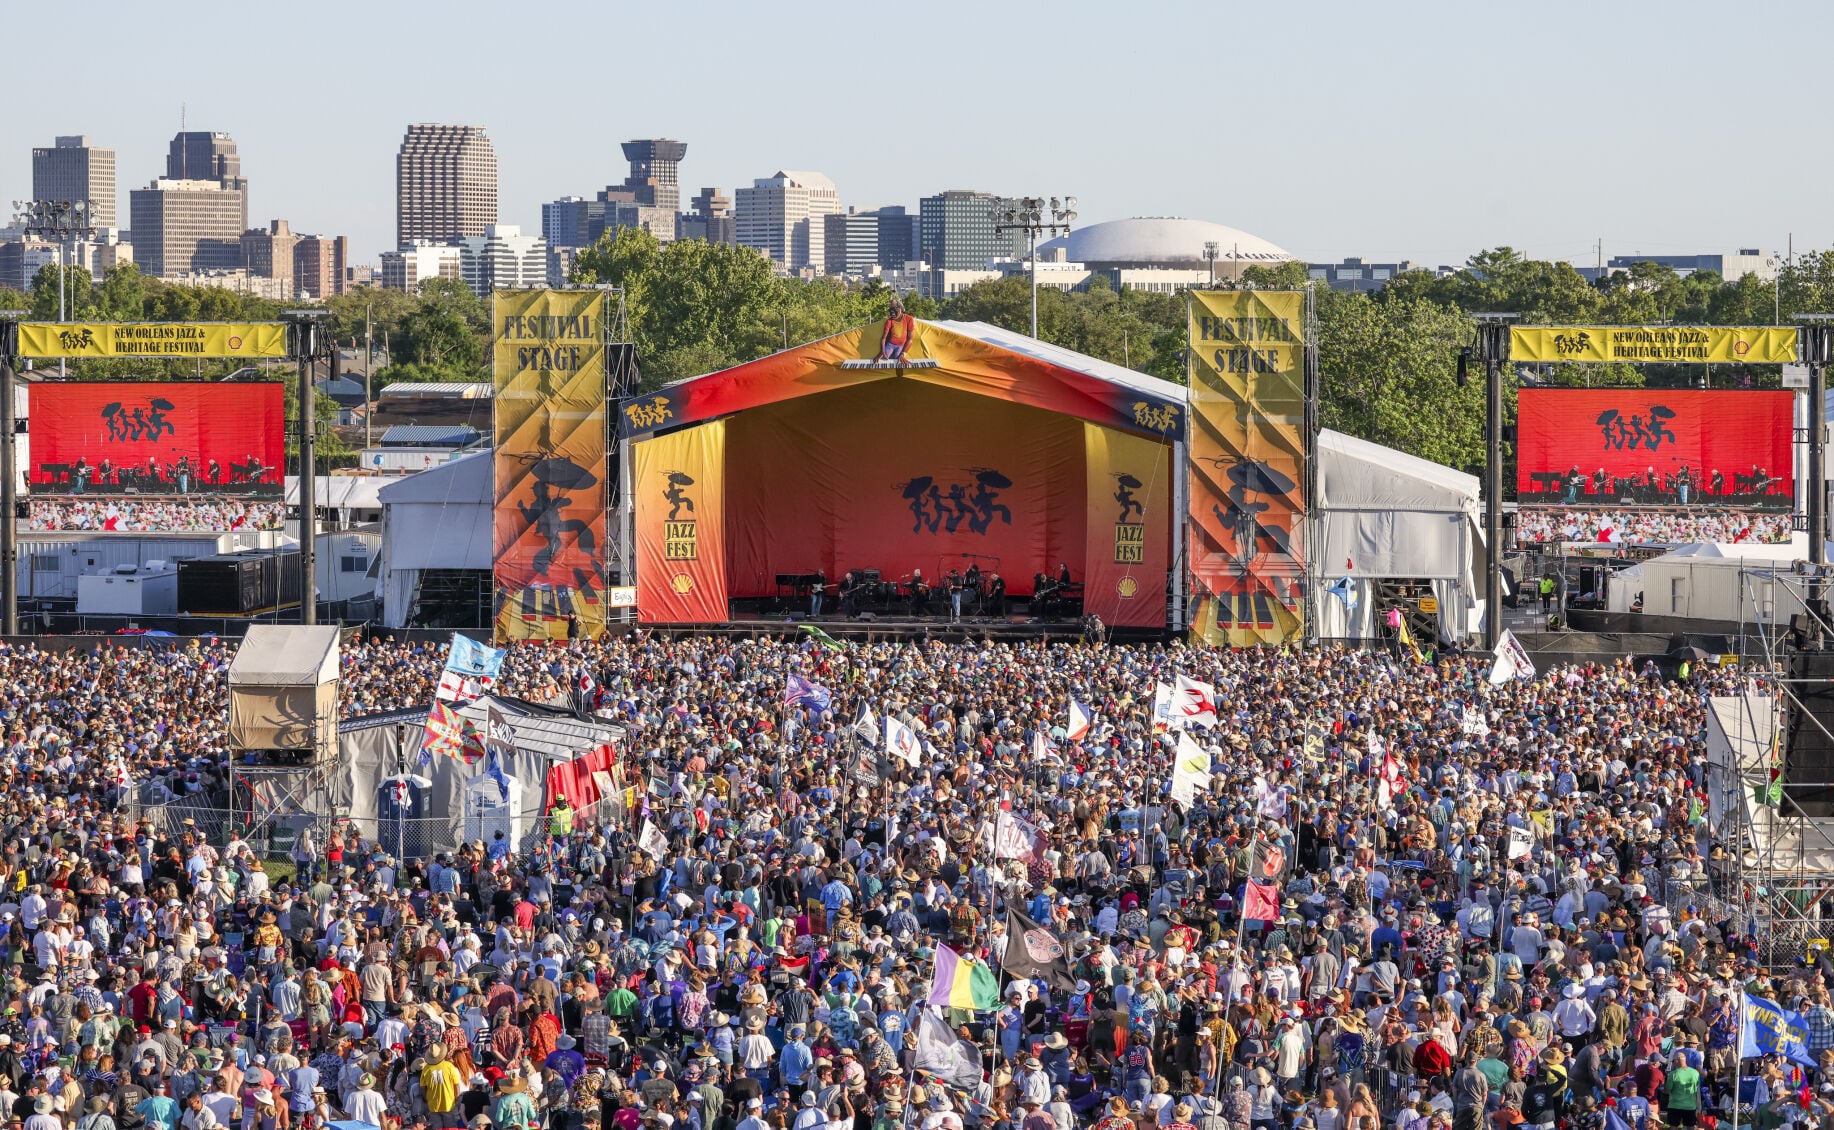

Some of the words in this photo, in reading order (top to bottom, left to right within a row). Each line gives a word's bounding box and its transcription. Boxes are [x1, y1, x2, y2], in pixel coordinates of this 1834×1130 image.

[114, 327, 134, 339] NEW
[135, 327, 174, 340] ORLEANS
[176, 328, 196, 340] JAZZ
[198, 331, 206, 340] &
[504, 315, 594, 340] FESTIVAL
[1200, 316, 1294, 342] FESTIVAL
[1613, 331, 1633, 343] NEW
[1635, 332, 1677, 343] ORLEANS
[1678, 332, 1700, 344] JAZZ
[1702, 334, 1710, 343] &
[115, 341, 161, 353] HERITAGE
[164, 341, 206, 353] FESTIVAL
[1613, 346, 1663, 358] HERITAGE
[1665, 346, 1710, 358] FESTIVAL
[518, 347, 580, 371] STAGE
[1214, 349, 1279, 374] STAGE
[666, 523, 695, 540] JAZZ
[1116, 526, 1143, 543] JAZZ
[666, 542, 696, 557] FEST
[1116, 545, 1143, 561] FEST
